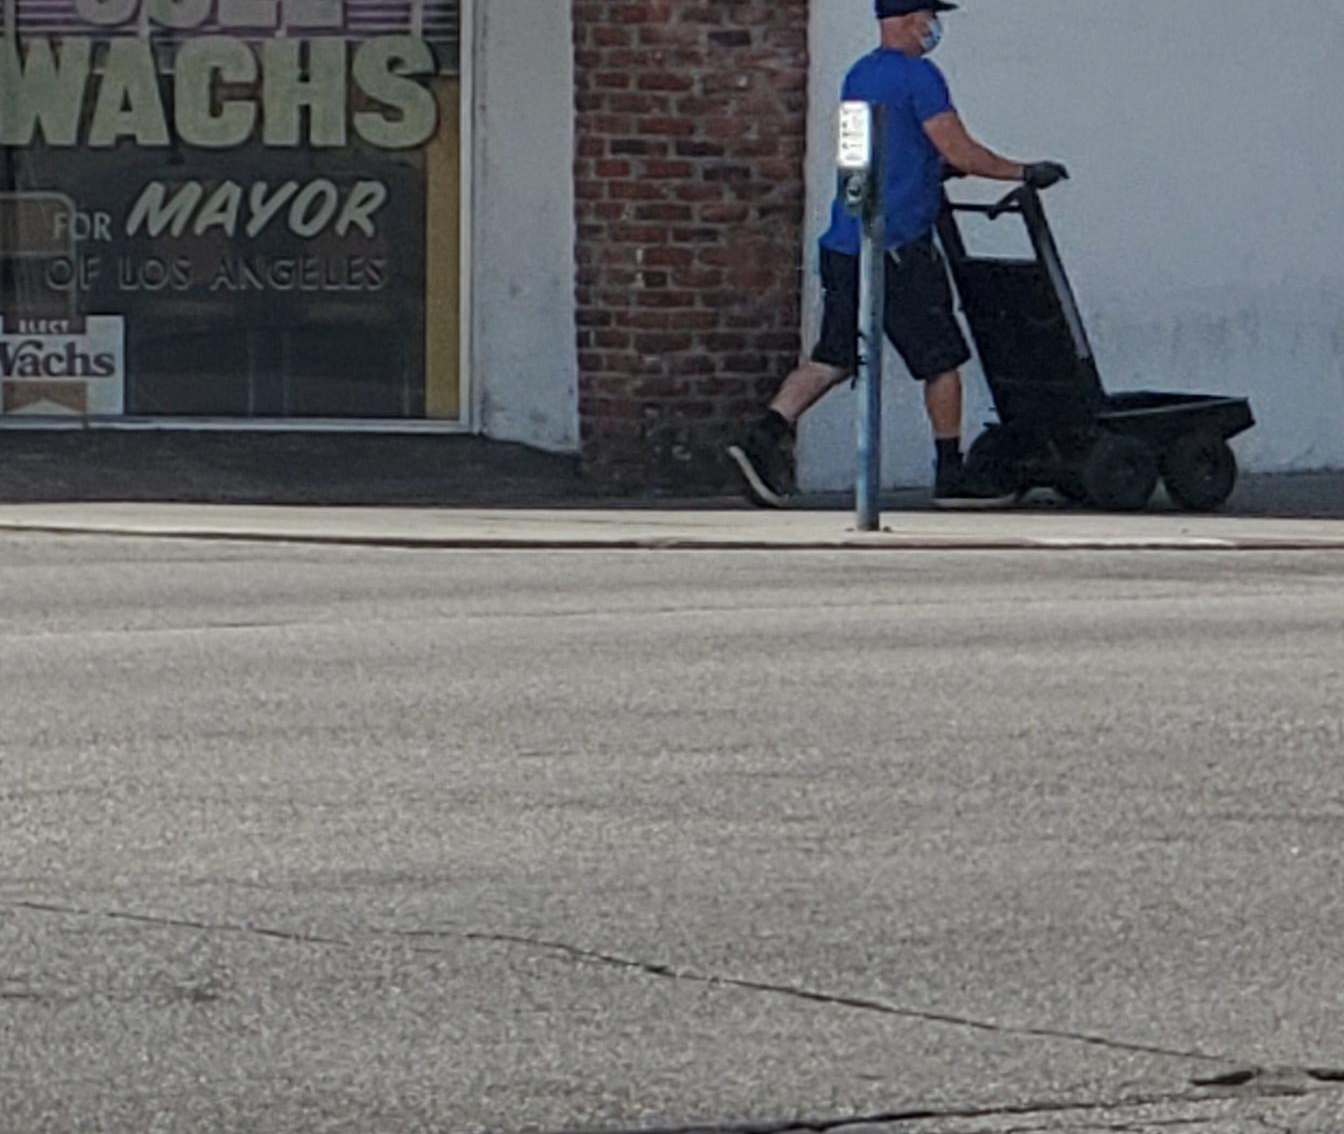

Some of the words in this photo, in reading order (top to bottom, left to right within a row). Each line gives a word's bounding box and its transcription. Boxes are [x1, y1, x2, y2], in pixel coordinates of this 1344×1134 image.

[52, 210, 112, 242] FOR
[125, 178, 389, 239] MAYOR
[45, 255, 100, 291] OF
[119, 257, 191, 291] LOS
[210, 257, 389, 292] ANGELES
[18, 319, 70, 333] ELECT
